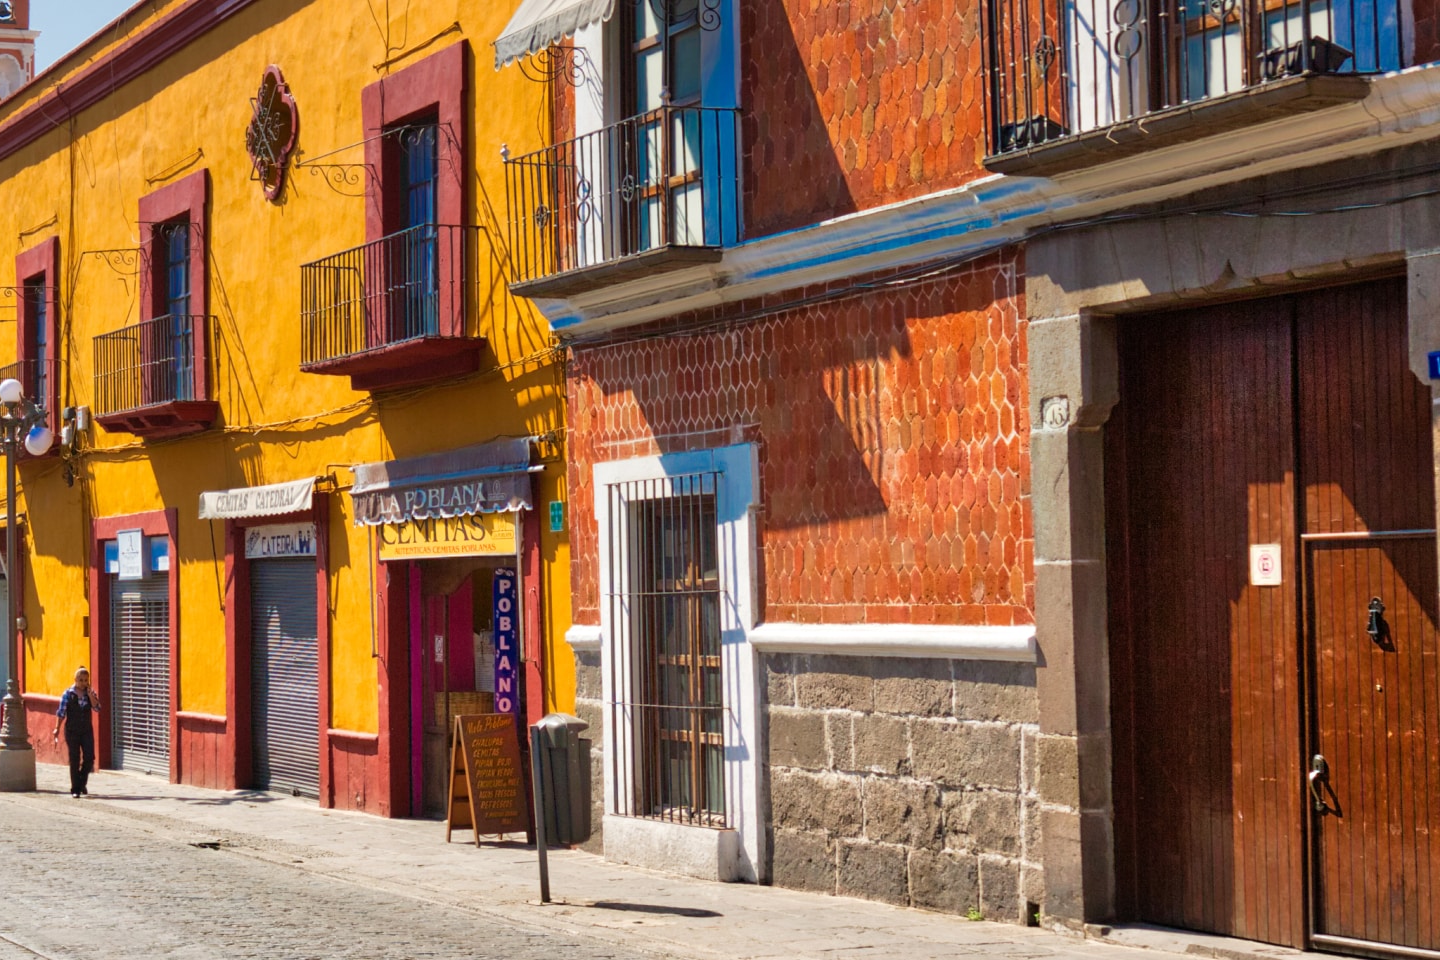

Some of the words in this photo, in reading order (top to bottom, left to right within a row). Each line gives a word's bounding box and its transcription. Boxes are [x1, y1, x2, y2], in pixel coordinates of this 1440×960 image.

[216, 493, 249, 512] CEMITAS
[380, 493, 401, 514] LA
[405, 482, 487, 511] POBLANA
[380, 514, 486, 546] CEMITAS
[261, 534, 299, 555] CATEDRAL
[432, 545, 460, 554] CEMITAS
[461, 543, 497, 553] POBLANAS
[498, 579, 511, 712] POBLANO
